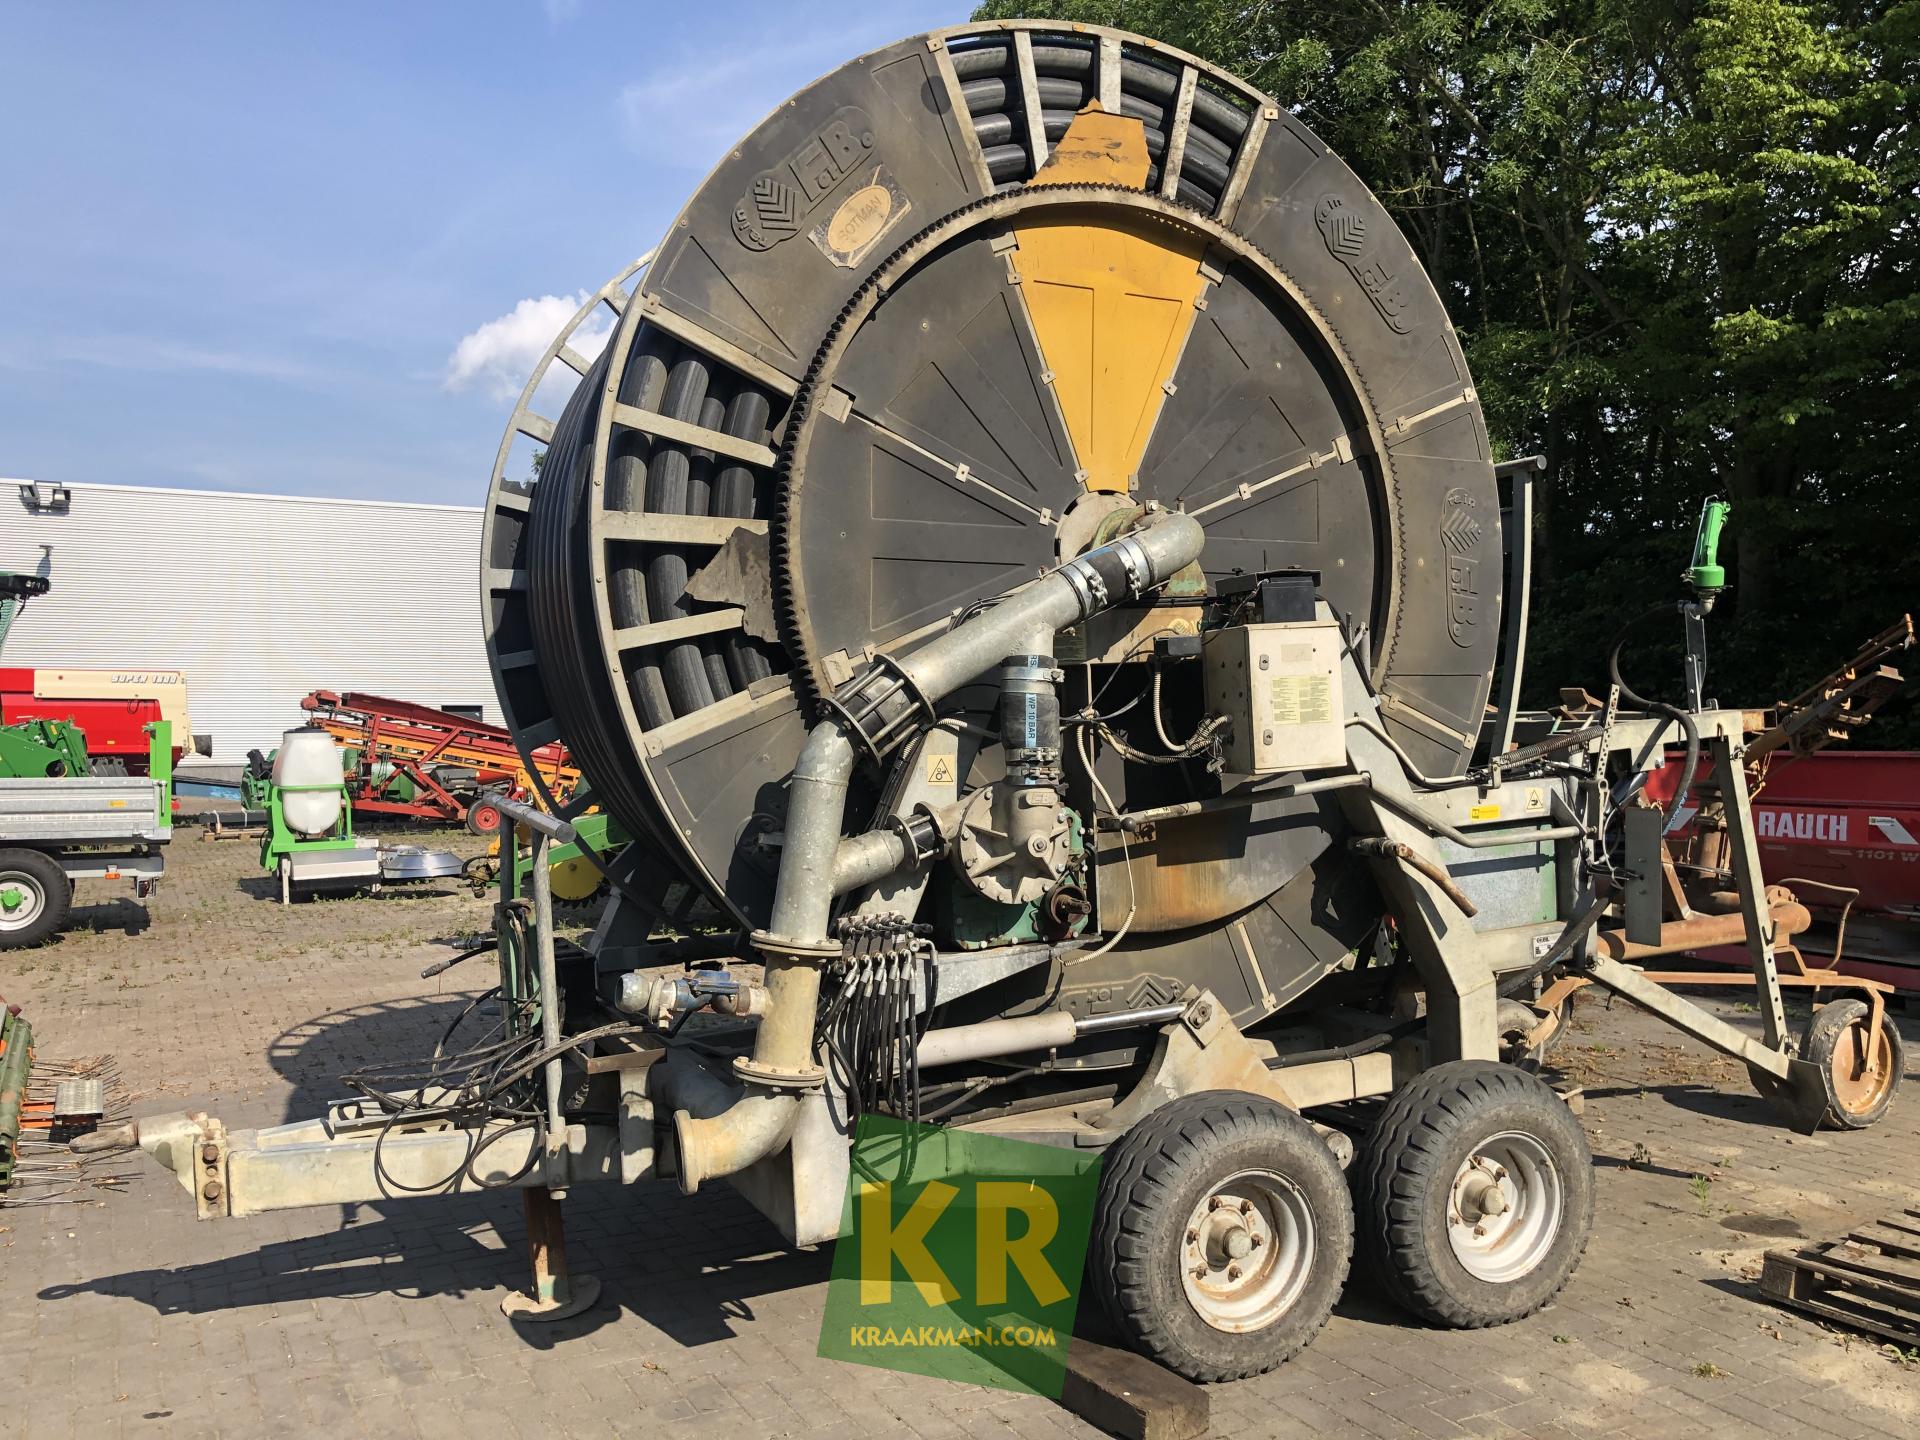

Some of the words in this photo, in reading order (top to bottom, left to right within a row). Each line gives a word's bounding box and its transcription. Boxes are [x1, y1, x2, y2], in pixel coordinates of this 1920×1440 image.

[1027, 696, 1036, 710] WP
[1027, 711, 1036, 720] 10
[1027, 721, 1036, 739] BAR
[1758, 811, 1848, 842] RAUCH
[1856, 850, 1894, 860] 1101
